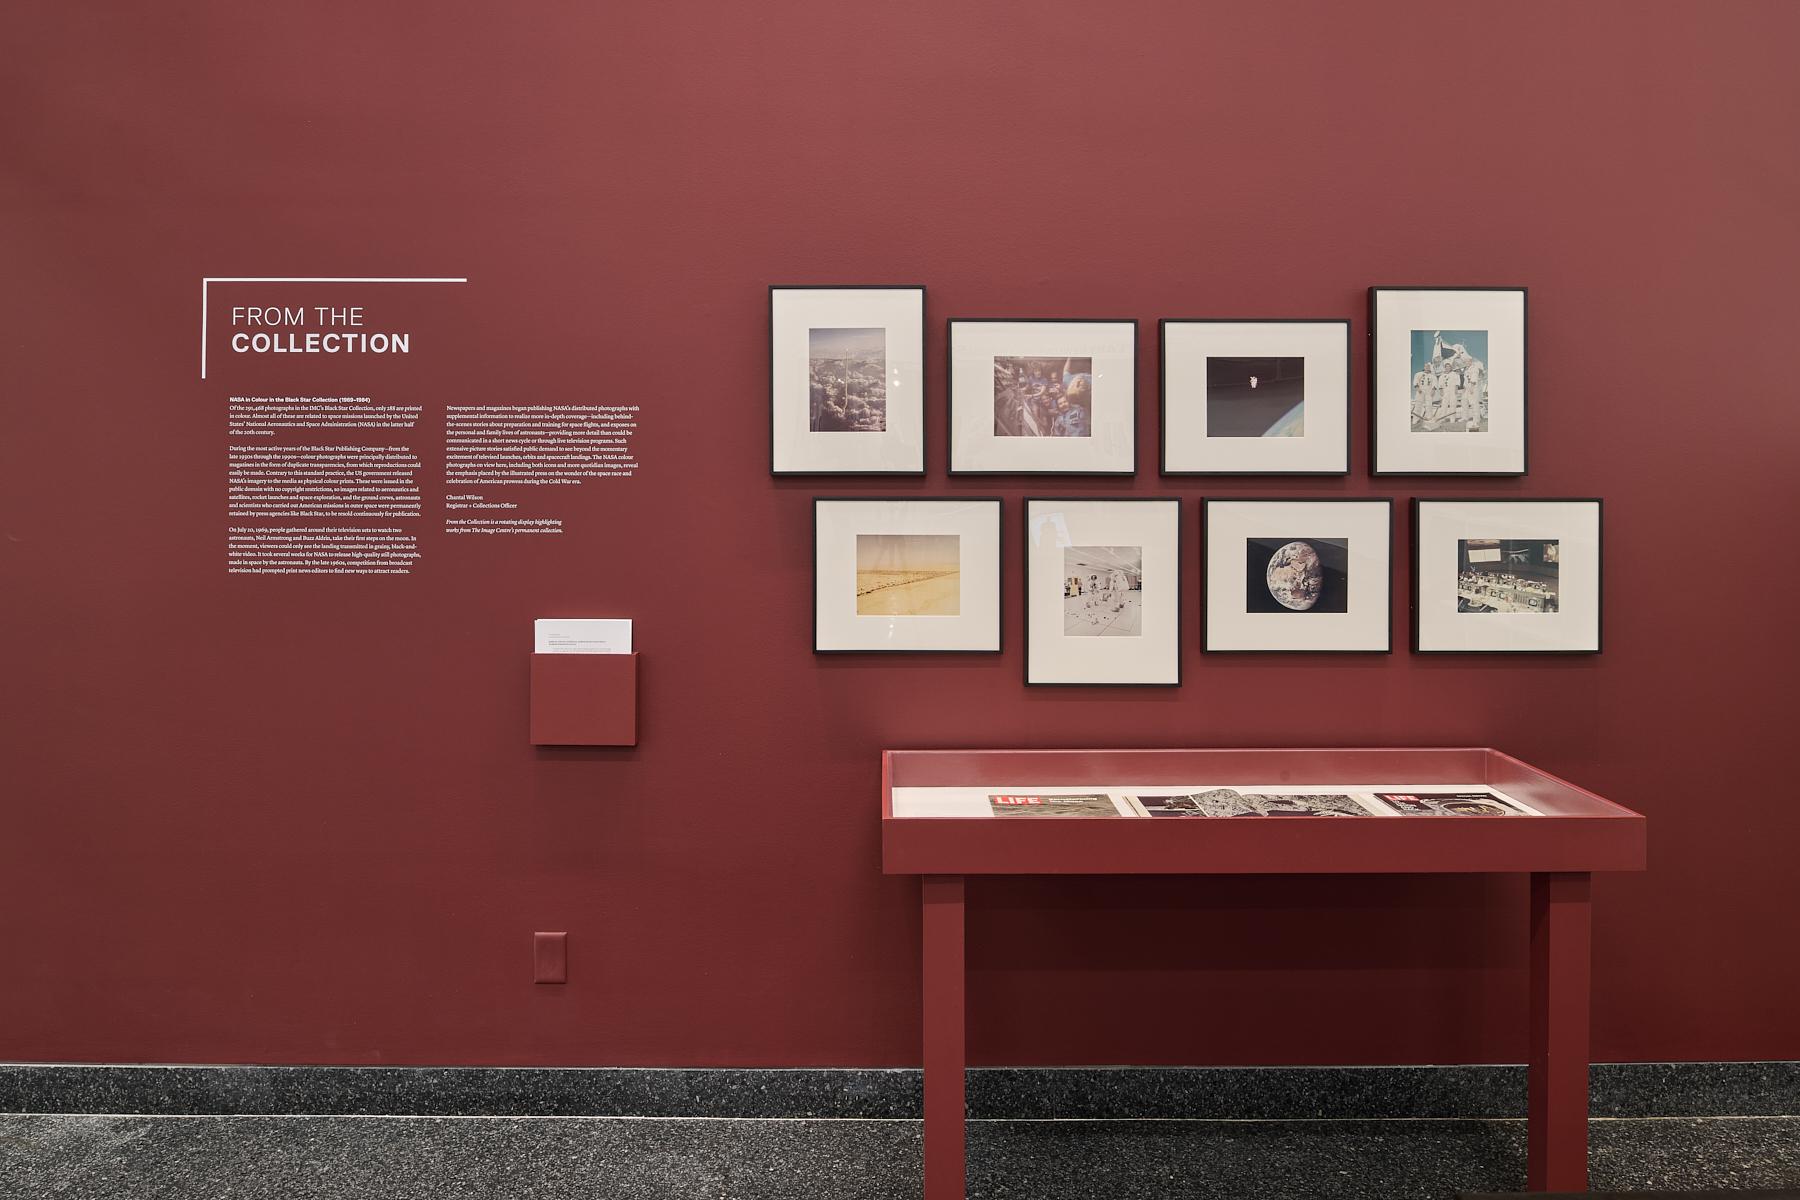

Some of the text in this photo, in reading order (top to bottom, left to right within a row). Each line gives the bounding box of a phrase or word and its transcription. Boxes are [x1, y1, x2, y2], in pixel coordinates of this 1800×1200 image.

[232, 307, 364, 326] FROM THE
[231, 333, 410, 353] COLLECTION
[376, 405, 386, 413] only
[571, 454, 592, 462] landings.
[996, 796, 1041, 804] LIFE
